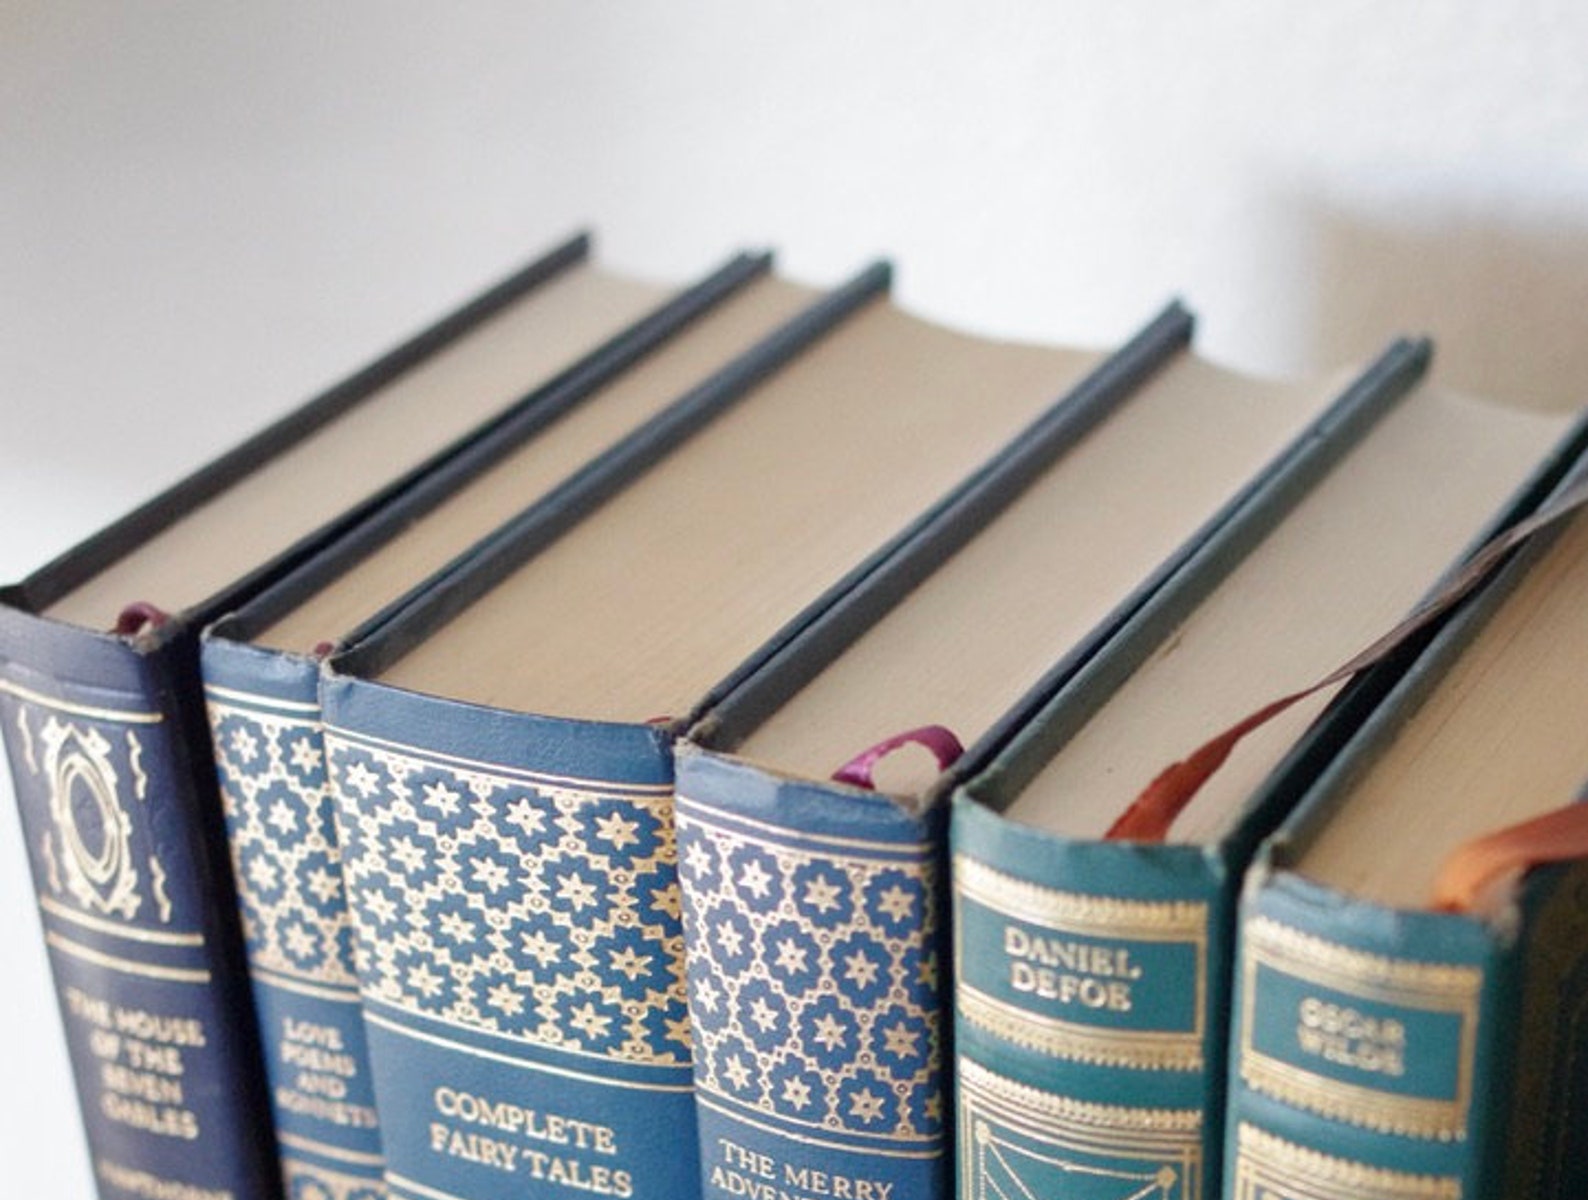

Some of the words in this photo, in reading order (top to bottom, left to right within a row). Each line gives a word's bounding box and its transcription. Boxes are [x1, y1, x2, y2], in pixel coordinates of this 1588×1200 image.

[1004, 925, 1143, 979] DANIEL
[1010, 960, 1133, 1013] DEFOE
[434, 1086, 617, 1156] COMPLETE
[429, 1121, 519, 1171] FAIRY
[522, 1149, 633, 1199] TALES
[718, 1138, 776, 1180] THE
